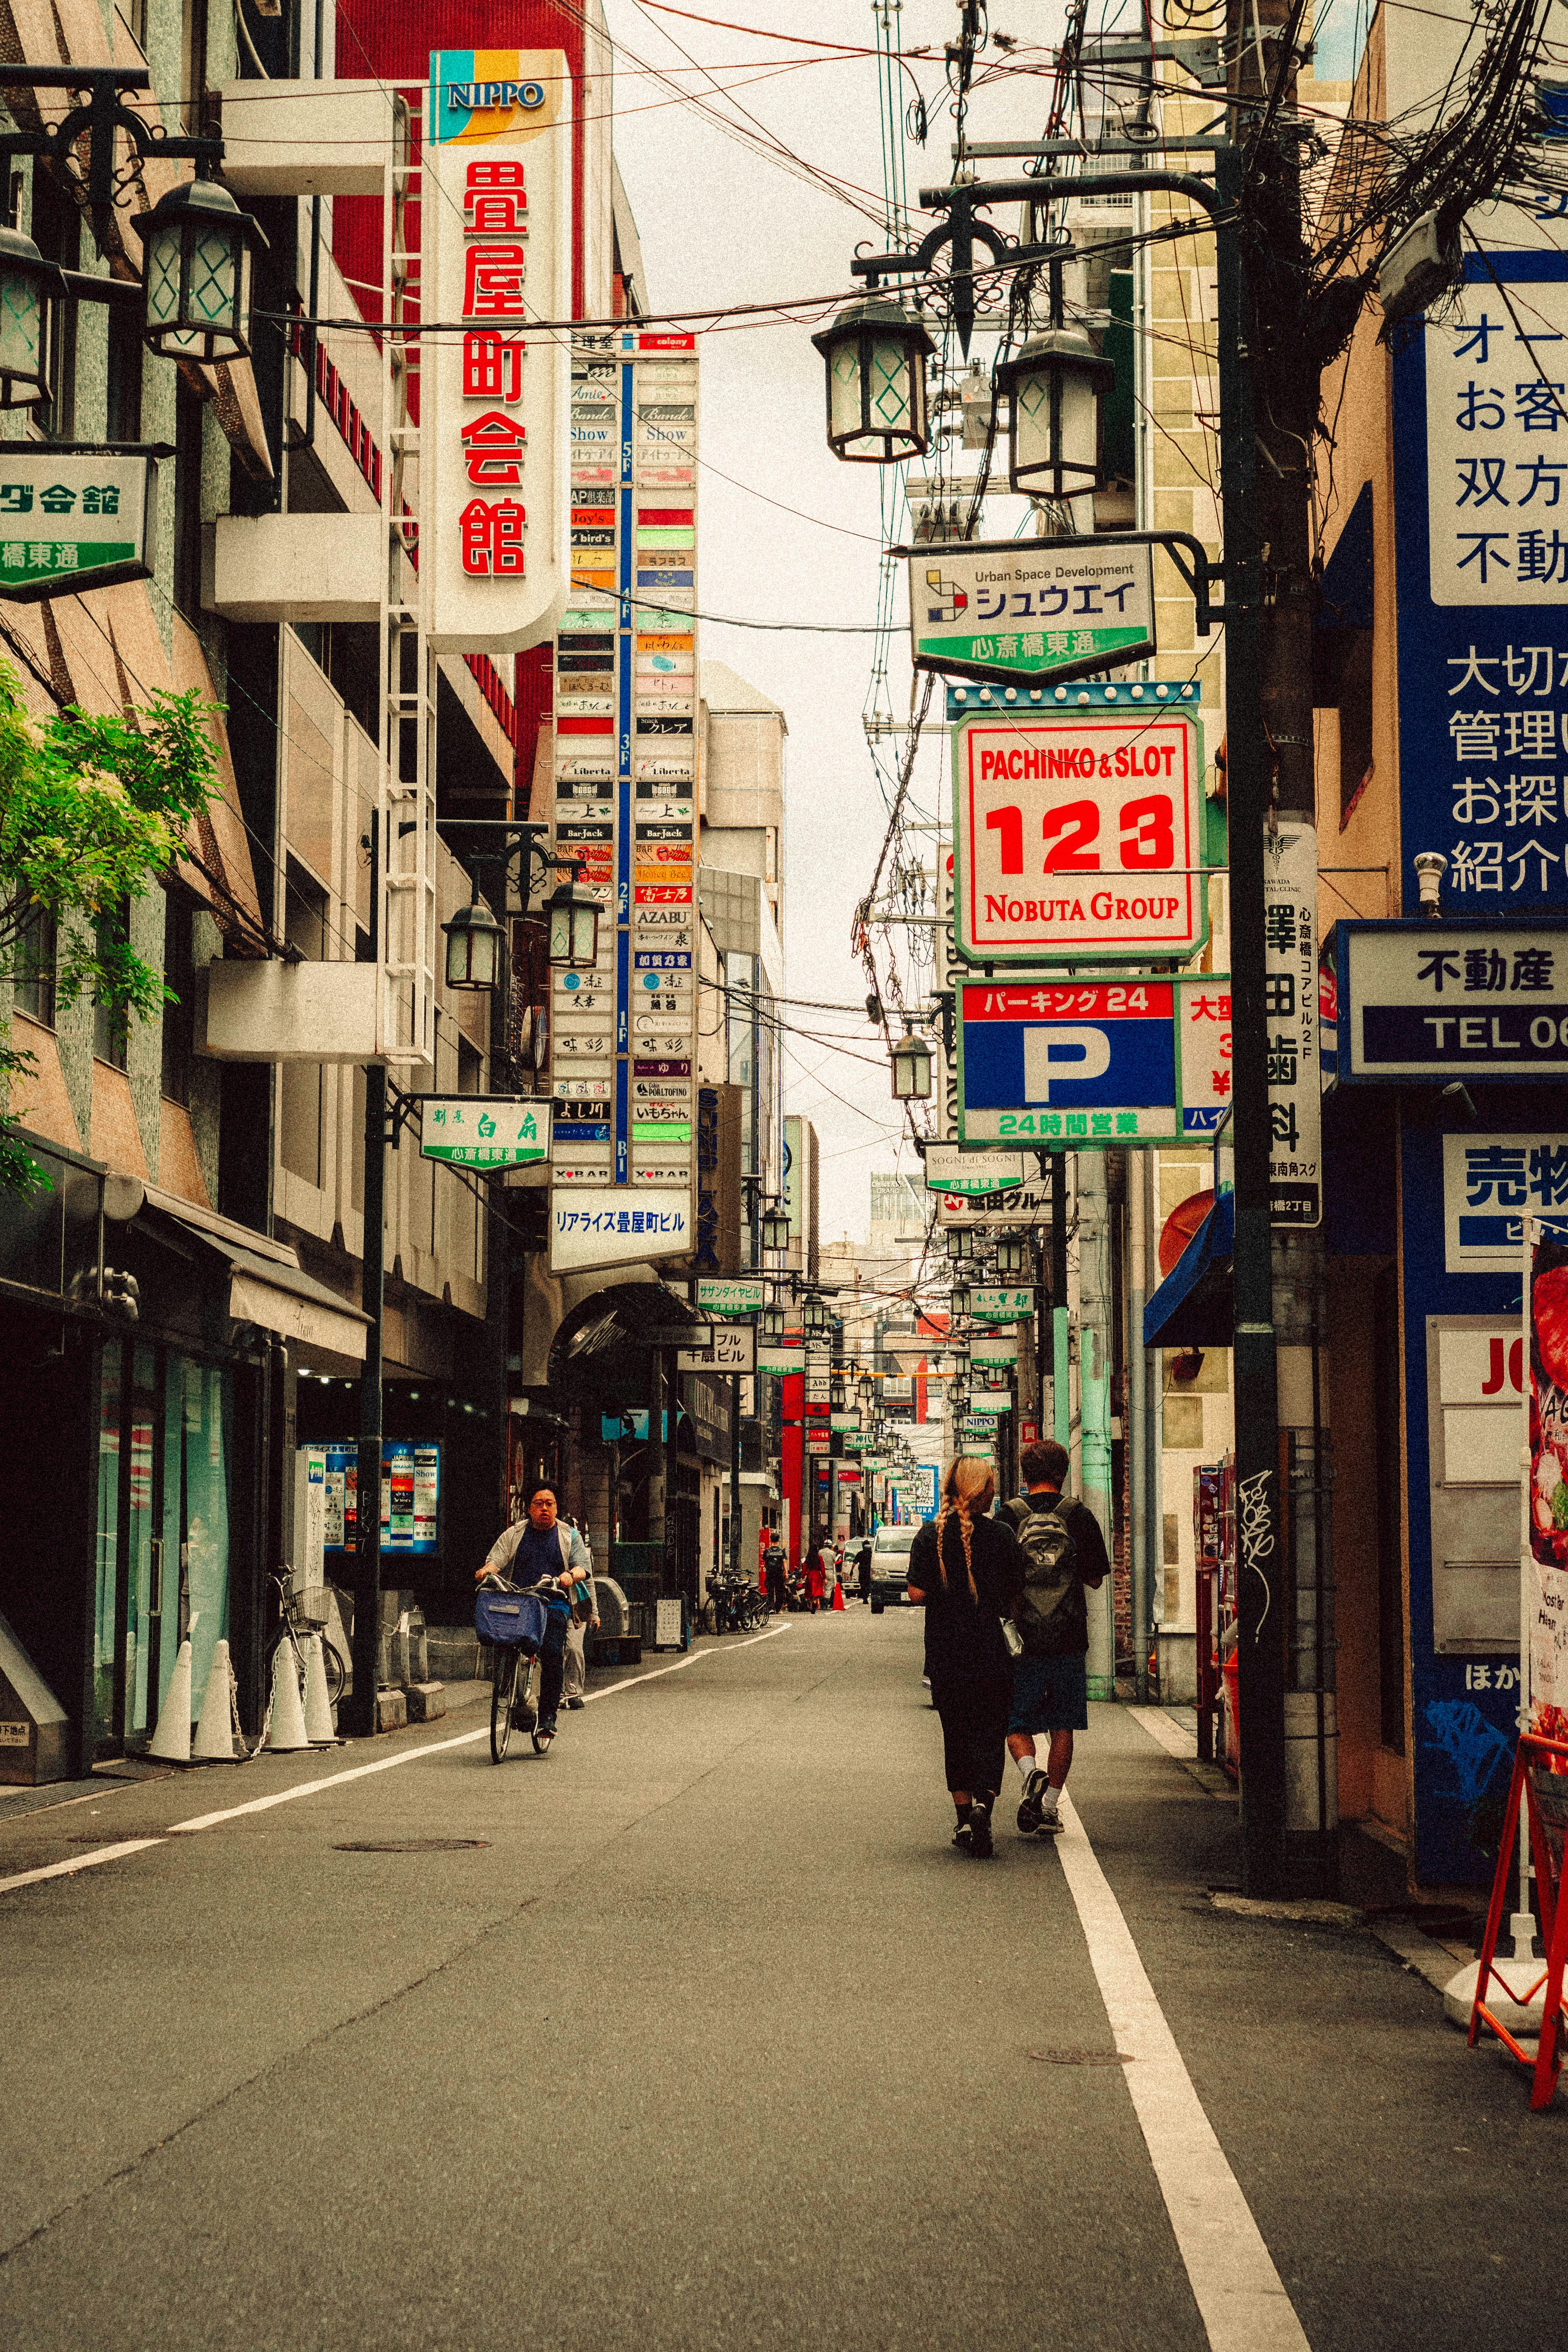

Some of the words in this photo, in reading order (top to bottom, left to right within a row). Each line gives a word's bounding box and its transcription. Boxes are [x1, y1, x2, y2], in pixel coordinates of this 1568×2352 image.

[447, 82, 546, 109] NIPPO
[657, 337, 687, 346] colony
[459, 162, 528, 578] 畳屋町会館
[641, 406, 691, 420] Bande
[1456, 379, 1568, 432] お客
[571, 427, 608, 440] Show
[647, 427, 687, 441] Show
[622, 442, 632, 472] 5F
[1456, 455, 1568, 507] 双方
[571, 513, 604, 525] Joy's
[581, 534, 611, 543] bird's
[2, 543, 79, 568] 橋東通
[1456, 529, 1568, 584] 不動
[975, 571, 1011, 583] Urban
[1015, 569, 1051, 582] Space
[1056, 564, 1134, 578] Development
[977, 582, 1134, 620] シュウエイ
[972, 631, 1095, 659] 心斎橋東通
[1447, 645, 1568, 695] 大切
[650, 724, 687, 734] クレア
[1449, 710, 1568, 761] 管理
[621, 734, 630, 765] 3F
[981, 748, 1094, 780] PACHINKO
[1099, 757, 1112, 778] &
[1116, 746, 1175, 777] SLOT
[581, 804, 595, 818] 上
[659, 804, 674, 818] 上
[1453, 774, 1568, 826] お探
[986, 794, 1174, 874] 123
[1451, 840, 1568, 892] 紹介
[619, 882, 628, 913] 2F
[641, 887, 687, 902] 富士乃
[638, 911, 687, 923] AZABU
[675, 932, 688, 946] 泉
[1417, 948, 1554, 992] 不動産
[1299, 907, 1312, 1060] 心斎橋コアビル2F
[984, 990, 1099, 1013] パーキング
[1107, 987, 1149, 1012] 24
[619, 1011, 627, 1042] 1F
[1424, 1017, 1520, 1049] TEL
[563, 1038, 603, 1052] 味彩
[643, 1037, 683, 1052] 味彩
[658, 1063, 688, 1074] ゆり
[1024, 1027, 1111, 1102] P
[637, 1108, 688, 1119] いもちゃん
[1000, 1112, 1138, 1135] 24時間営業
[452, 1148, 516, 1162] 心斎橋東通
[618, 1141, 627, 1172] B1
[933, 1156, 965, 1164] SOGNI
[950, 1179, 1000, 1189] 心斎橋東通
[1465, 1145, 1568, 1207] 売物
[968, 1191, 1070, 1211] 延田グルー
[1270, 1200, 1311, 1211] 橋2丁目
[557, 1211, 684, 1233] リアライズ畳屋町ビル
[700, 1287, 760, 1298] サザンダイヤビル
[967, 1418, 995, 1426] NIPPO
[1025, 1426, 1035, 1439] 質
